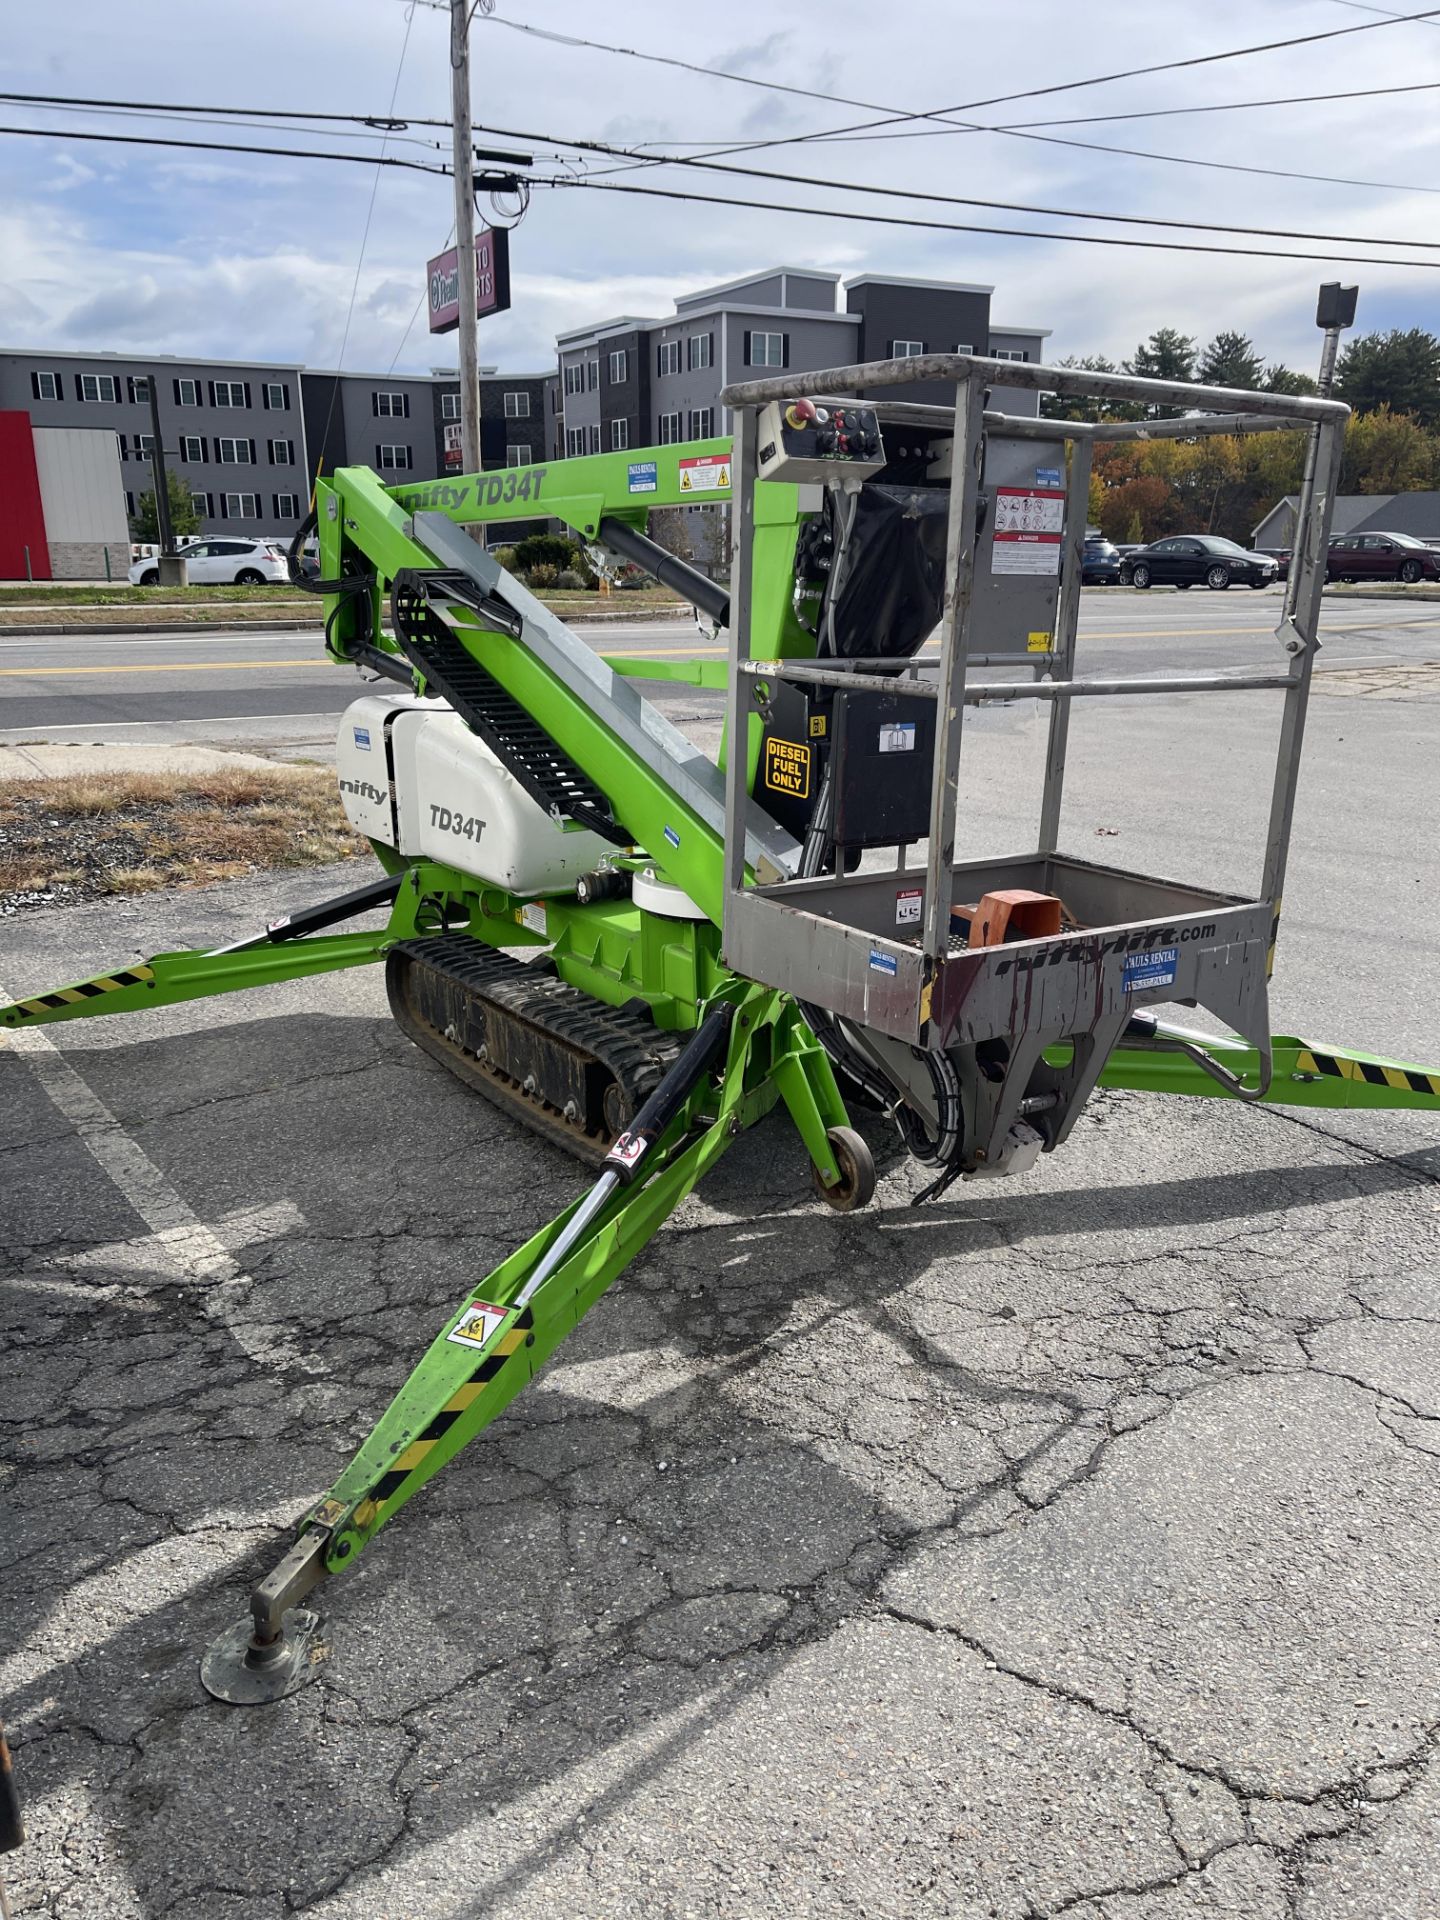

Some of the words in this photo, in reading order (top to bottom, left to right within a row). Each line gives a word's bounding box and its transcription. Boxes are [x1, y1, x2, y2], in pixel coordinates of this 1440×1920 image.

[476, 246, 489, 271] TO
[431, 269, 460, 312] O'Reill
[477, 272, 493, 297] RTS
[403, 485, 469, 510] nifty
[476, 468, 547, 507] TD34T
[769, 743, 808, 764] DIESEL
[774, 758, 802, 777] FUEL
[340, 779, 388, 805] nifty
[772, 772, 802, 790] ONLY
[430, 804, 487, 843] TD34T
[995, 923, 1216, 976] niftylift.com
[1149, 949, 1175, 965] RENTAL
